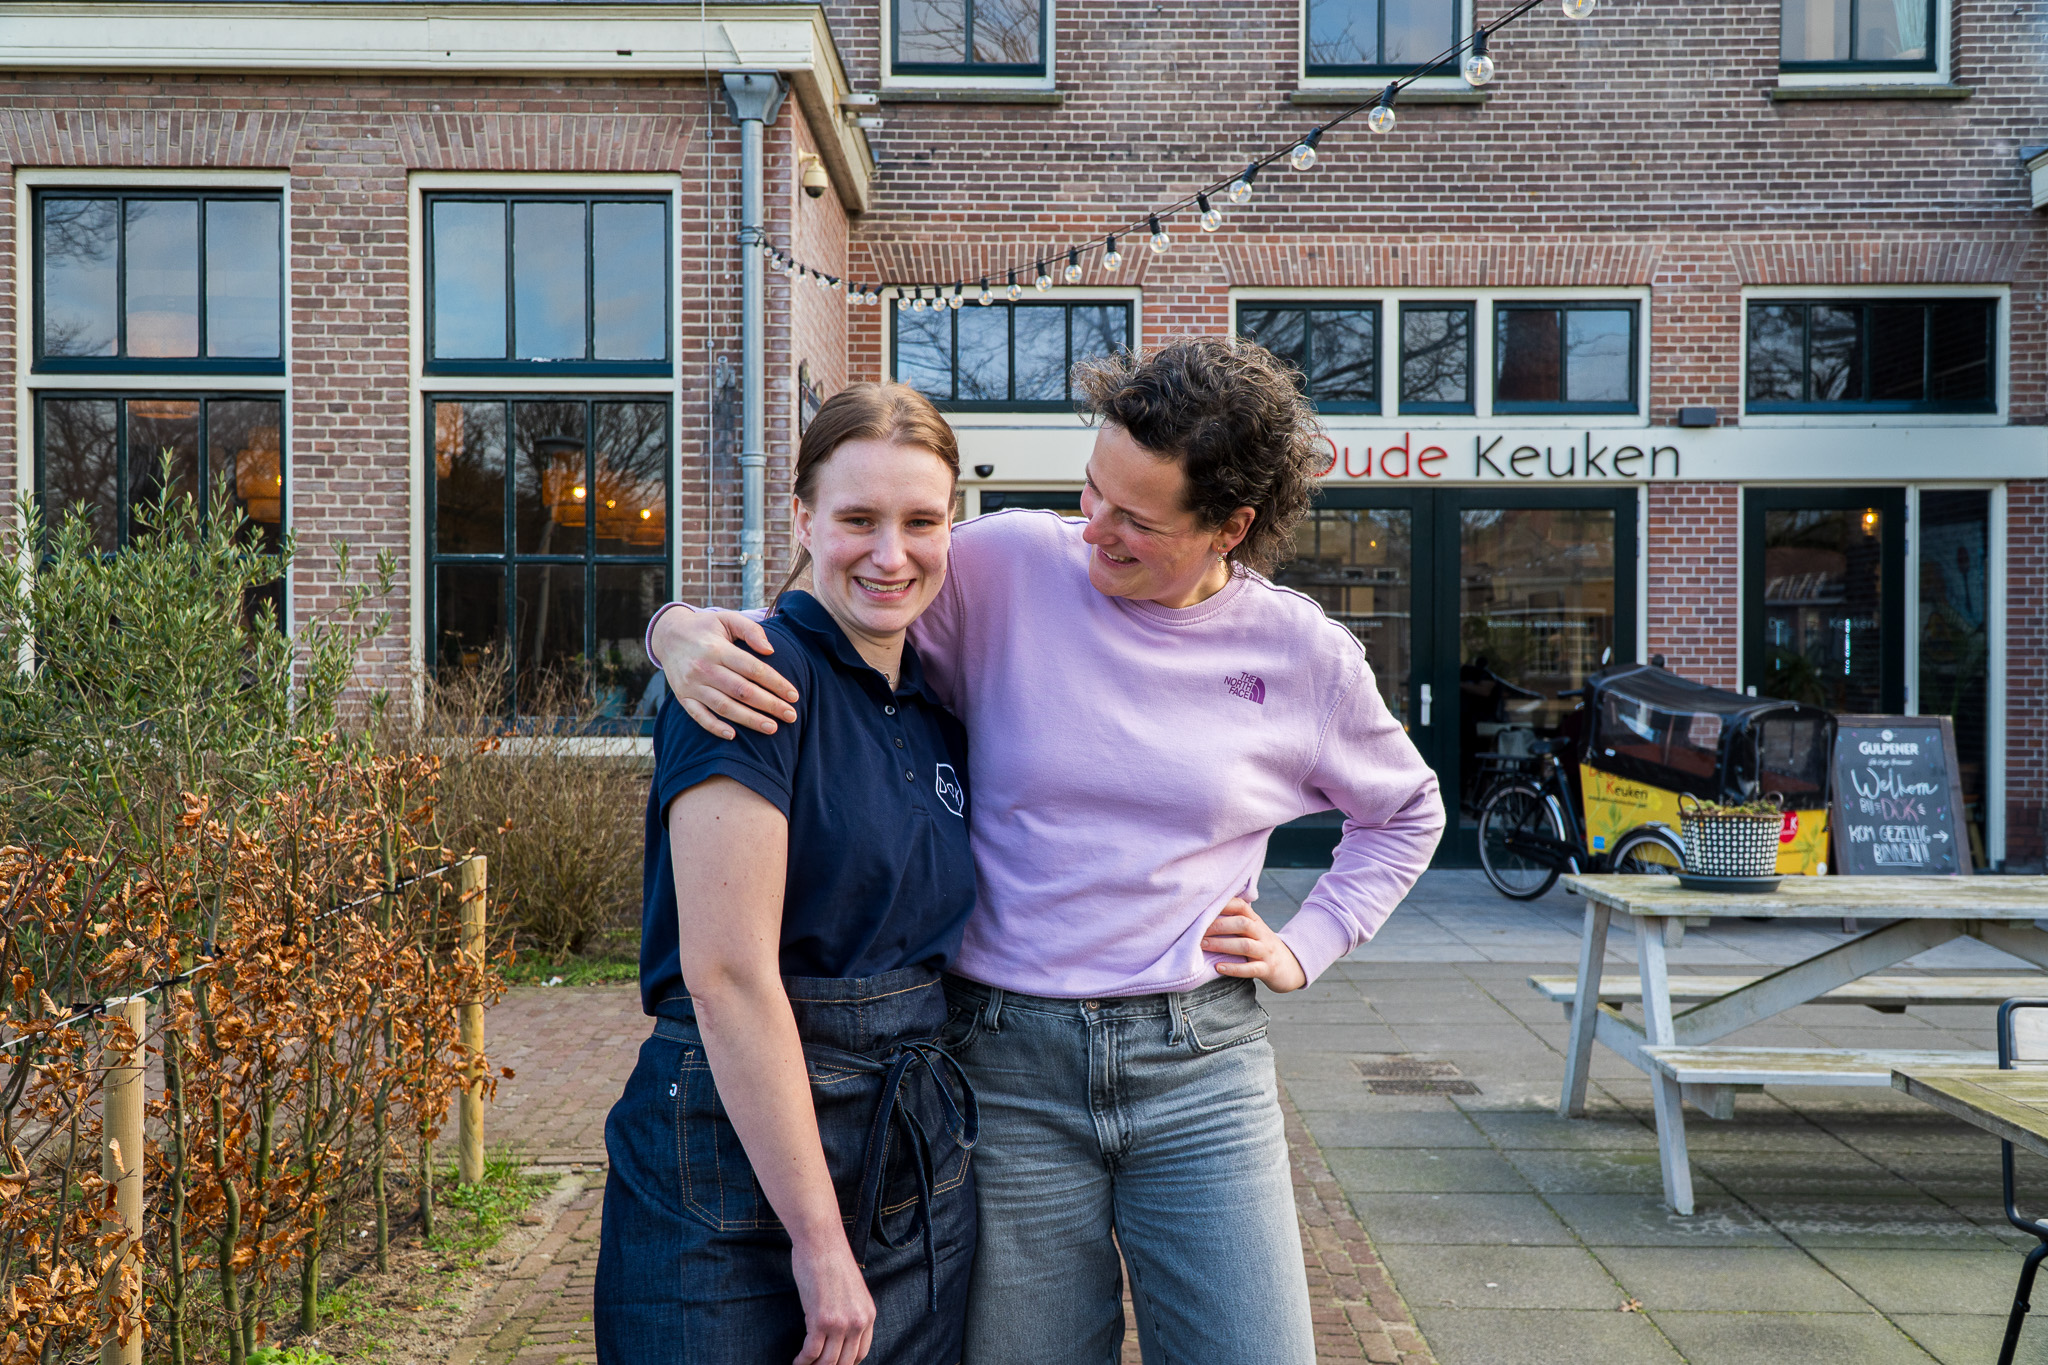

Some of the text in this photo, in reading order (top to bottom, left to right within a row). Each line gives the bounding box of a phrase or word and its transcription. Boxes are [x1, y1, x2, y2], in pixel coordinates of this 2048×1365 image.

[1475, 432, 1680, 477] Keuken
[1829, 618, 1877, 629] Keken
[1224, 676, 1253, 691] NORTH
[1241, 672, 1256, 684] THE
[1229, 687, 1249, 700] FACE
[1859, 741, 1919, 755] GULPENER
[1606, 780, 1648, 799] Keuken
[1851, 767, 1938, 799] Welkom
[1848, 825, 1876, 843] KOM
